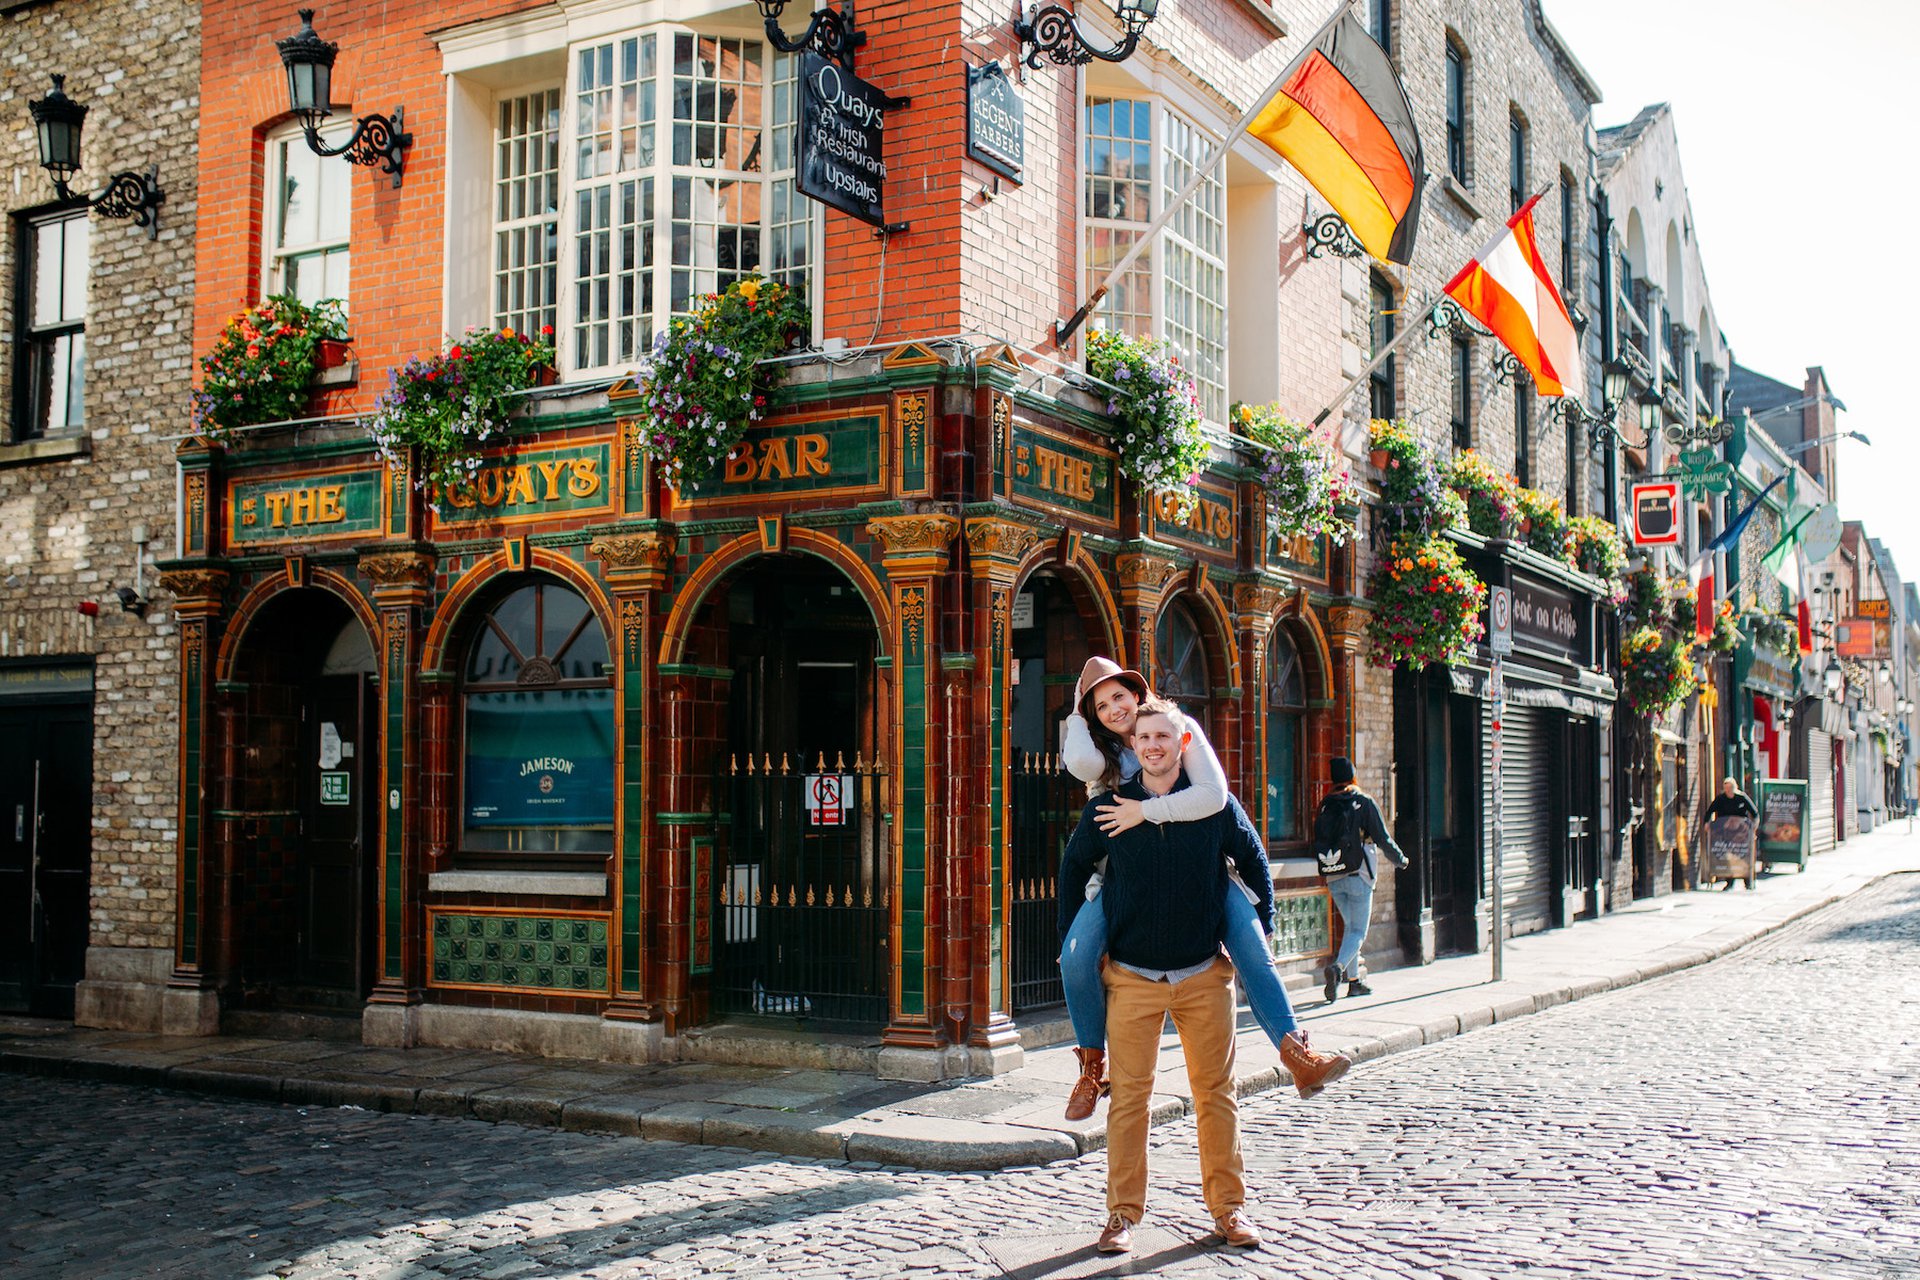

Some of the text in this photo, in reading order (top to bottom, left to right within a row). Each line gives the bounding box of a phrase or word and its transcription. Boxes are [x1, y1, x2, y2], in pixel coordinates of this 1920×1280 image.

[840, 122, 868, 149] Irish
[973, 93, 1021, 138] REGENT
[974, 118, 1021, 158] BARBERS
[1665, 423, 1735, 445] Quays
[723, 433, 832, 483] BAR
[1034, 445, 1095, 502] THE
[264, 484, 345, 528] THE
[1536, 606, 1550, 628] na
[520, 757, 574, 777] JAMESON
